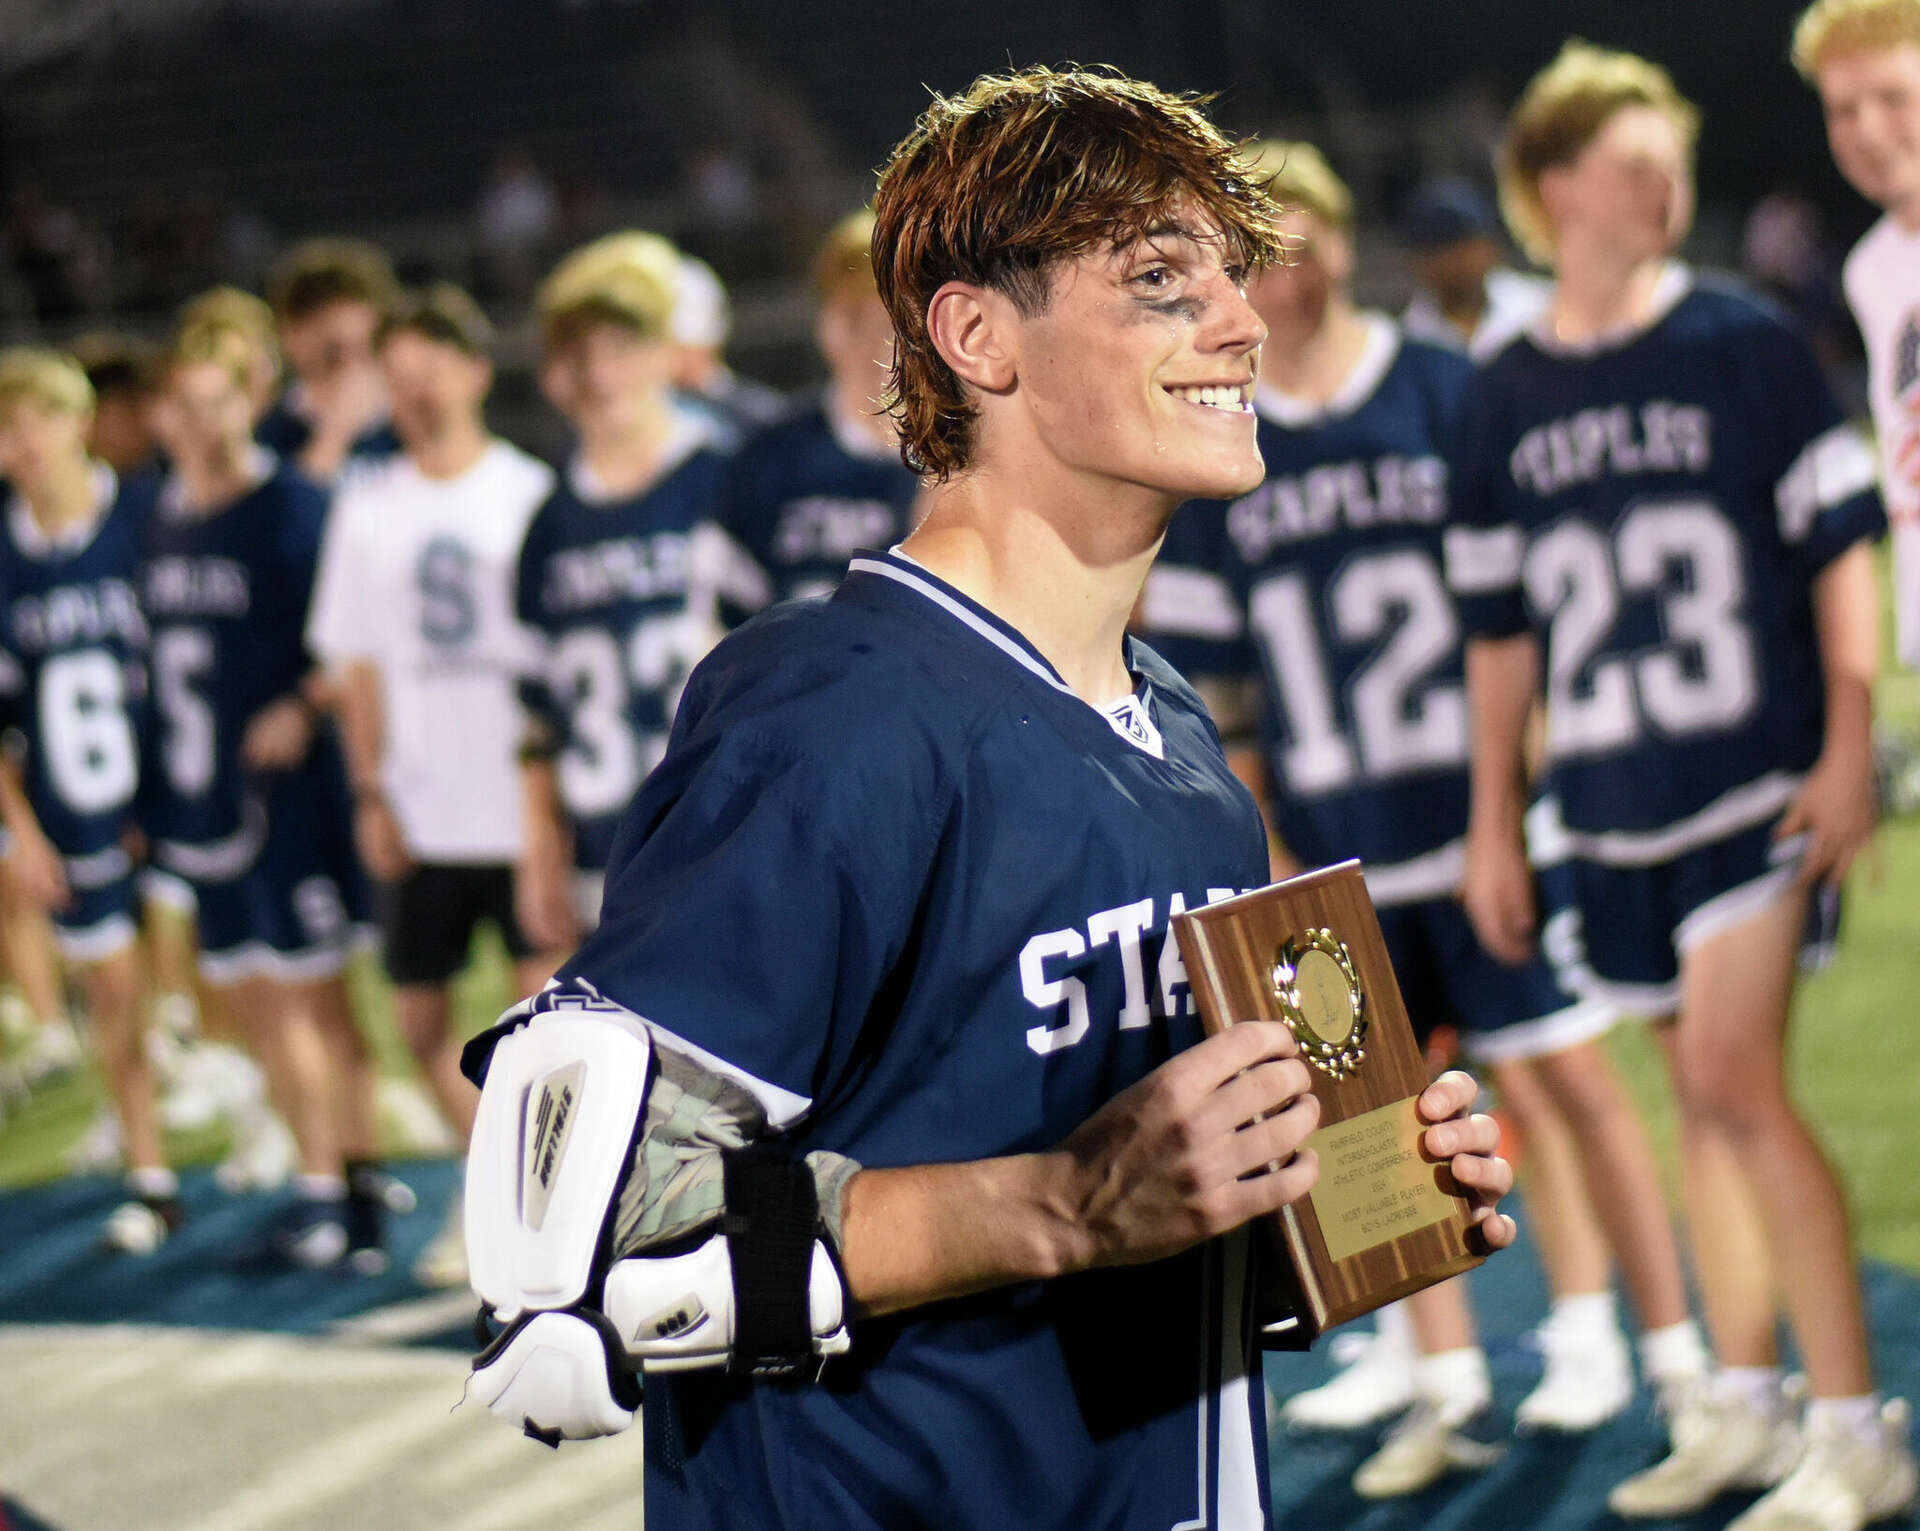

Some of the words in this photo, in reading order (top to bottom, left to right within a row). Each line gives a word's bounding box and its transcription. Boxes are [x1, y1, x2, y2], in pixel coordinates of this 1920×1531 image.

[416, 534, 477, 646] S
[1249, 548, 1472, 798] 12
[1521, 497, 1760, 768] 23
[39, 646, 141, 815] 6
[1400, 1183, 1425, 1201] PLAYER
